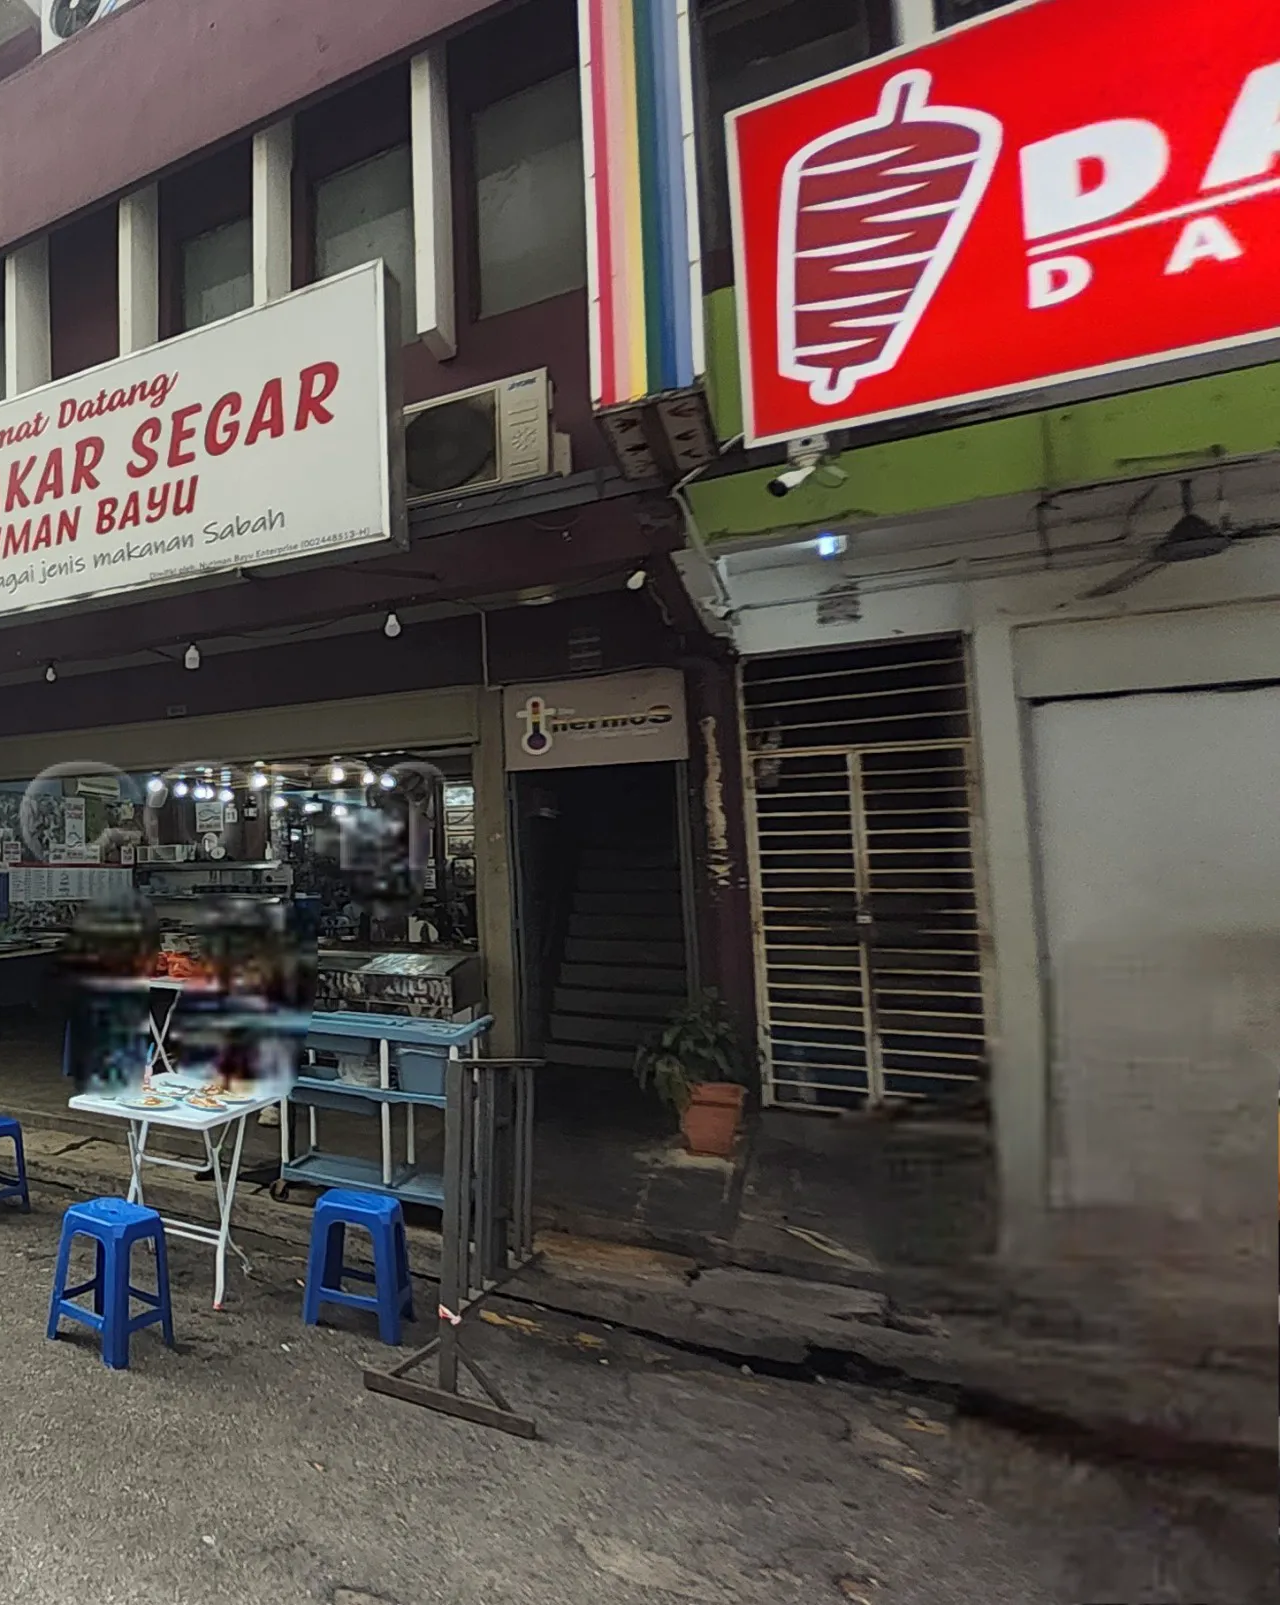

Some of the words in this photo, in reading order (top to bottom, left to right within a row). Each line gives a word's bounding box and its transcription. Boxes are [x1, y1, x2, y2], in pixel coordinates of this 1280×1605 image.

[57, 371, 179, 429] Datang
[126, 361, 340, 478] SEGAR
[95, 474, 199, 534] BAYU
[38, 554, 86, 584] jenis
[92, 532, 194, 568] makanan
[203, 508, 286, 544] Sabah
